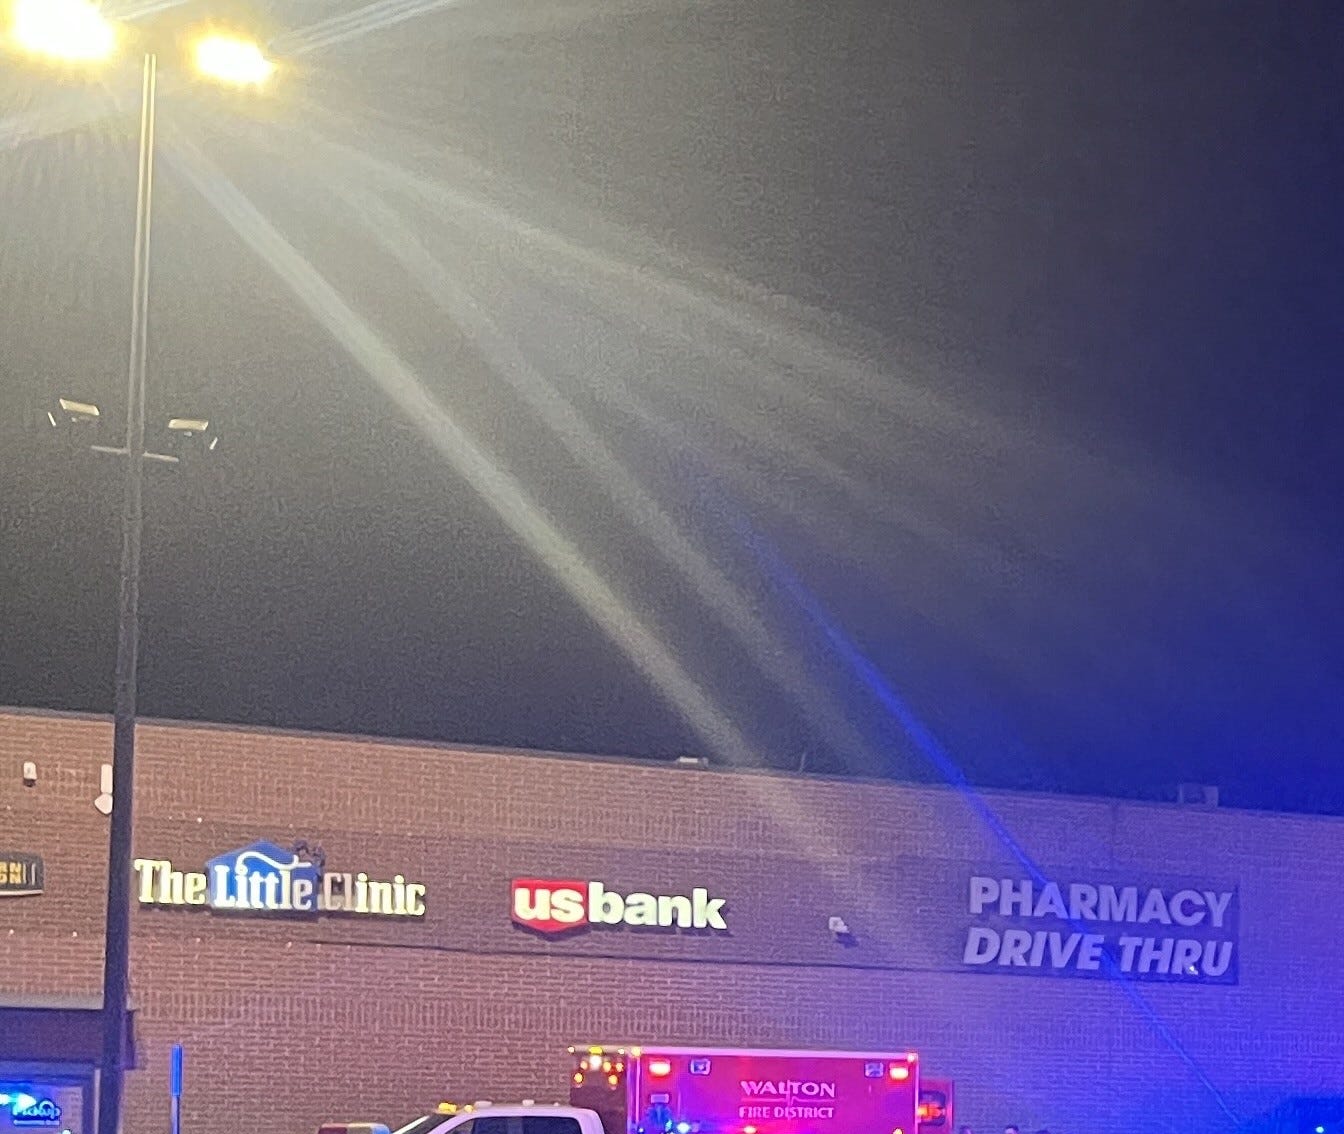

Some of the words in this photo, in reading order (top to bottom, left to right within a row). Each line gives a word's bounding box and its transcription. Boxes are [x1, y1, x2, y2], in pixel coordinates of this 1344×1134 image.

[134, 858, 206, 905] The
[214, 858, 313, 911] Little
[323, 872, 426, 916] Clinic
[969, 877, 1232, 928] PHARMACY
[963, 927, 1105, 970] DRIVE
[1119, 936, 1233, 977] THRU
[739, 1106, 771, 1118] FIRE
[774, 1106, 834, 1118] DISTRICT
[740, 1080, 835, 1098] WALTON
